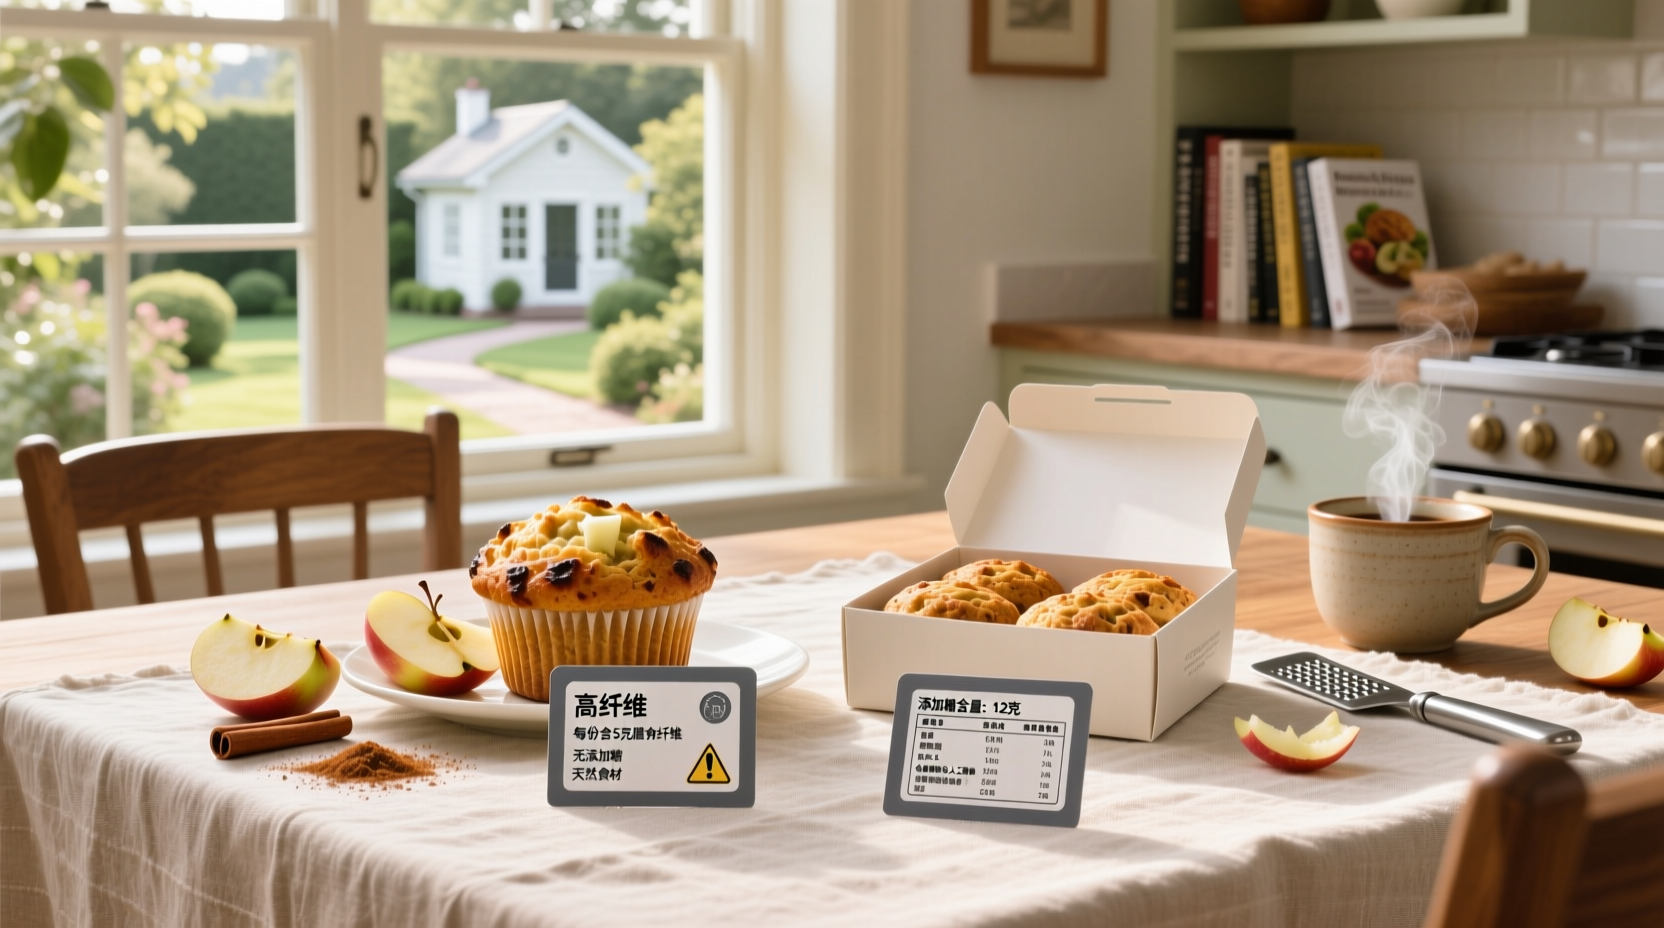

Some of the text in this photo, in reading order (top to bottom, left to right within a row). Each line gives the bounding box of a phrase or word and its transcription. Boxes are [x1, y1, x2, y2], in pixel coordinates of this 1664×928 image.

[574, 693, 647, 718] 高纤维
[993, 701, 1021, 716] 12克
